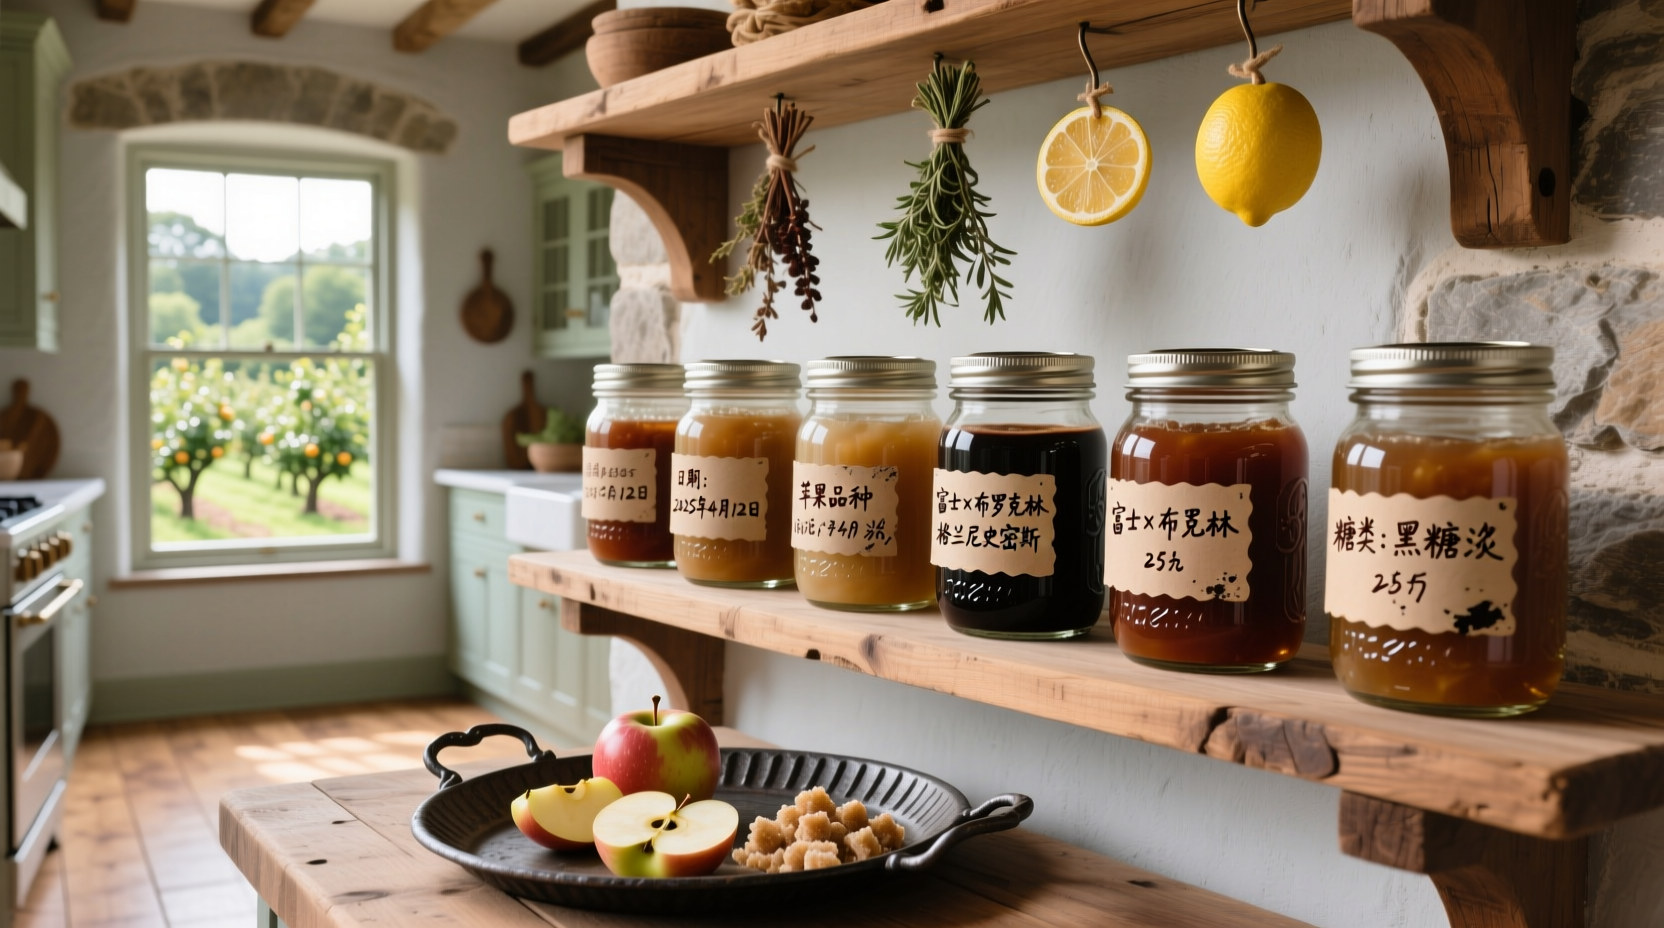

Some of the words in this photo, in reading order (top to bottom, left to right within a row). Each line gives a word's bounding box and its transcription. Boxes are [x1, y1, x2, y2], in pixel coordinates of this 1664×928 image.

[799, 480, 873, 512] 苹果品种
[936, 522, 1041, 553] 格兰尼史密斯
